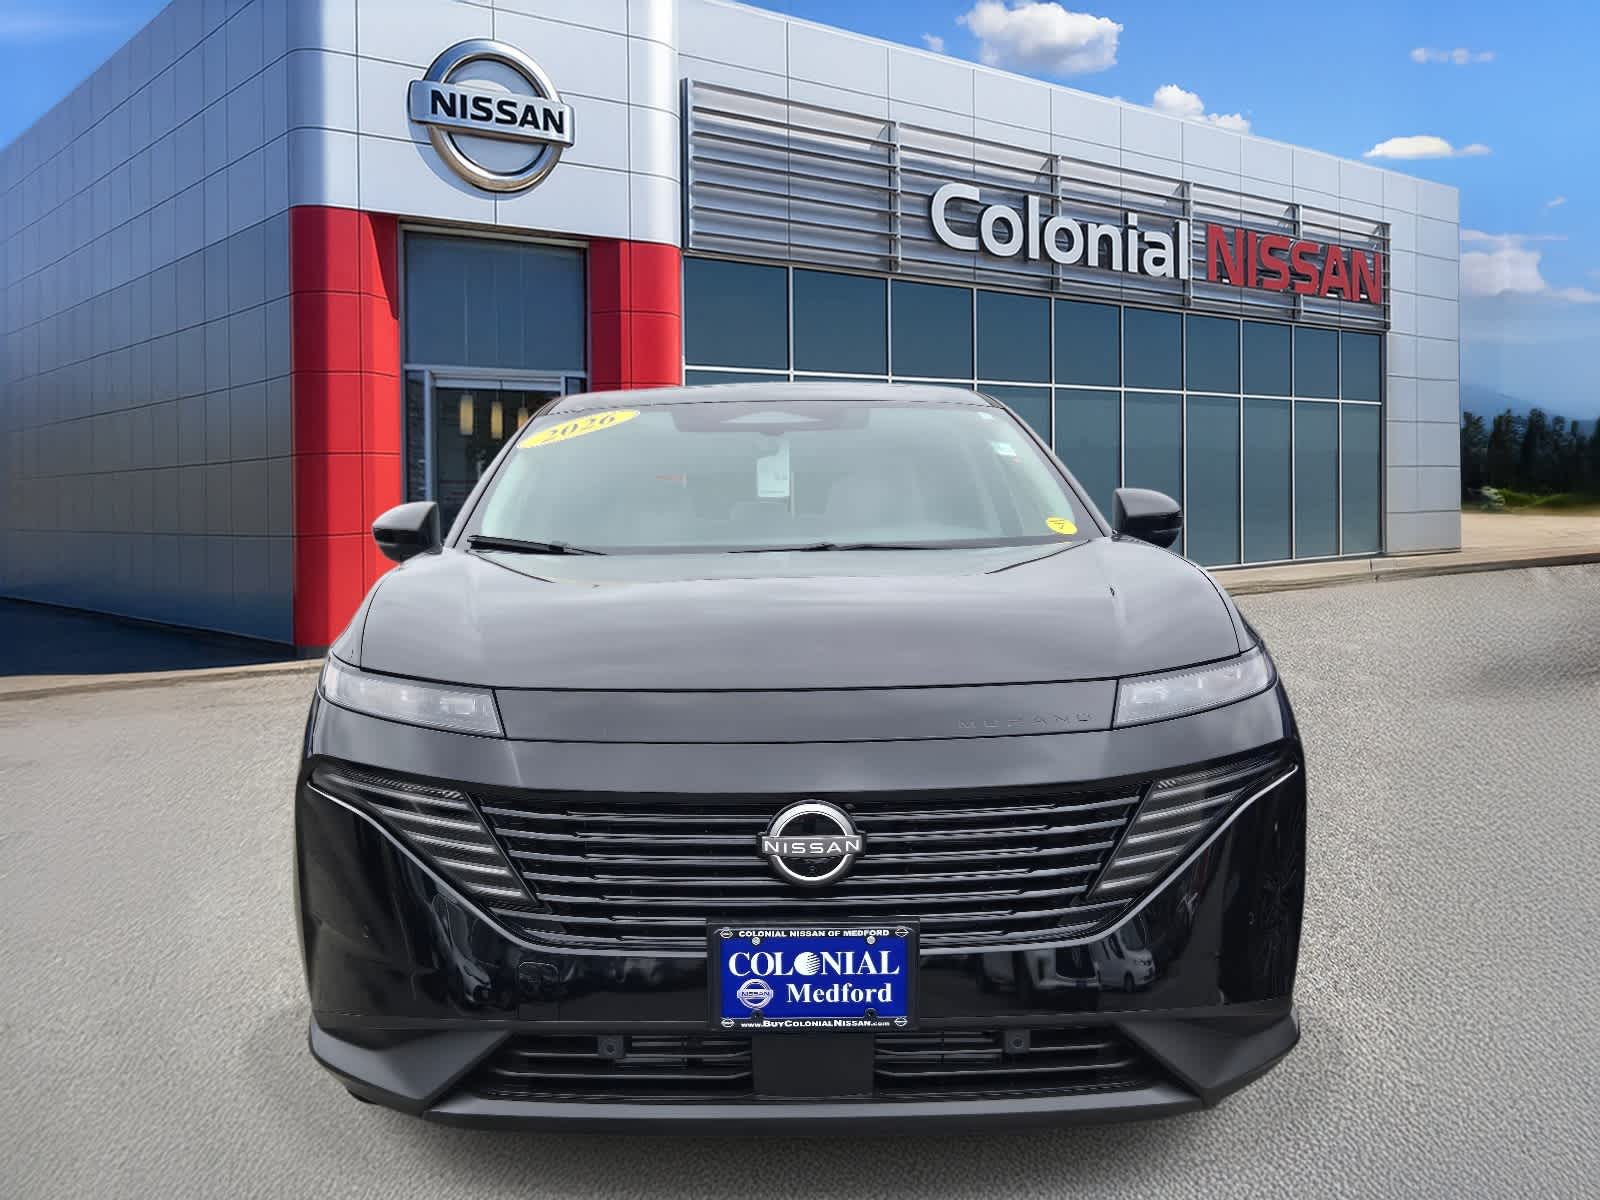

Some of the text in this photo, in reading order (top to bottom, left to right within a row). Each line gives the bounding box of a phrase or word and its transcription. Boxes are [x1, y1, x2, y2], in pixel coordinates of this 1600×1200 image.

[430, 90, 565, 134] NISSAN
[930, 183, 1384, 304] Colonial NISSAN
[764, 840, 860, 854] NISSAN
[738, 929, 787, 937] COLONIAL
[789, 929, 826, 937] NISSAN
[828, 929, 841, 937] OF
[843, 929, 890, 937] MEDFORD
[728, 951, 900, 977] COLONIAL
[786, 982, 893, 1003] Medford
